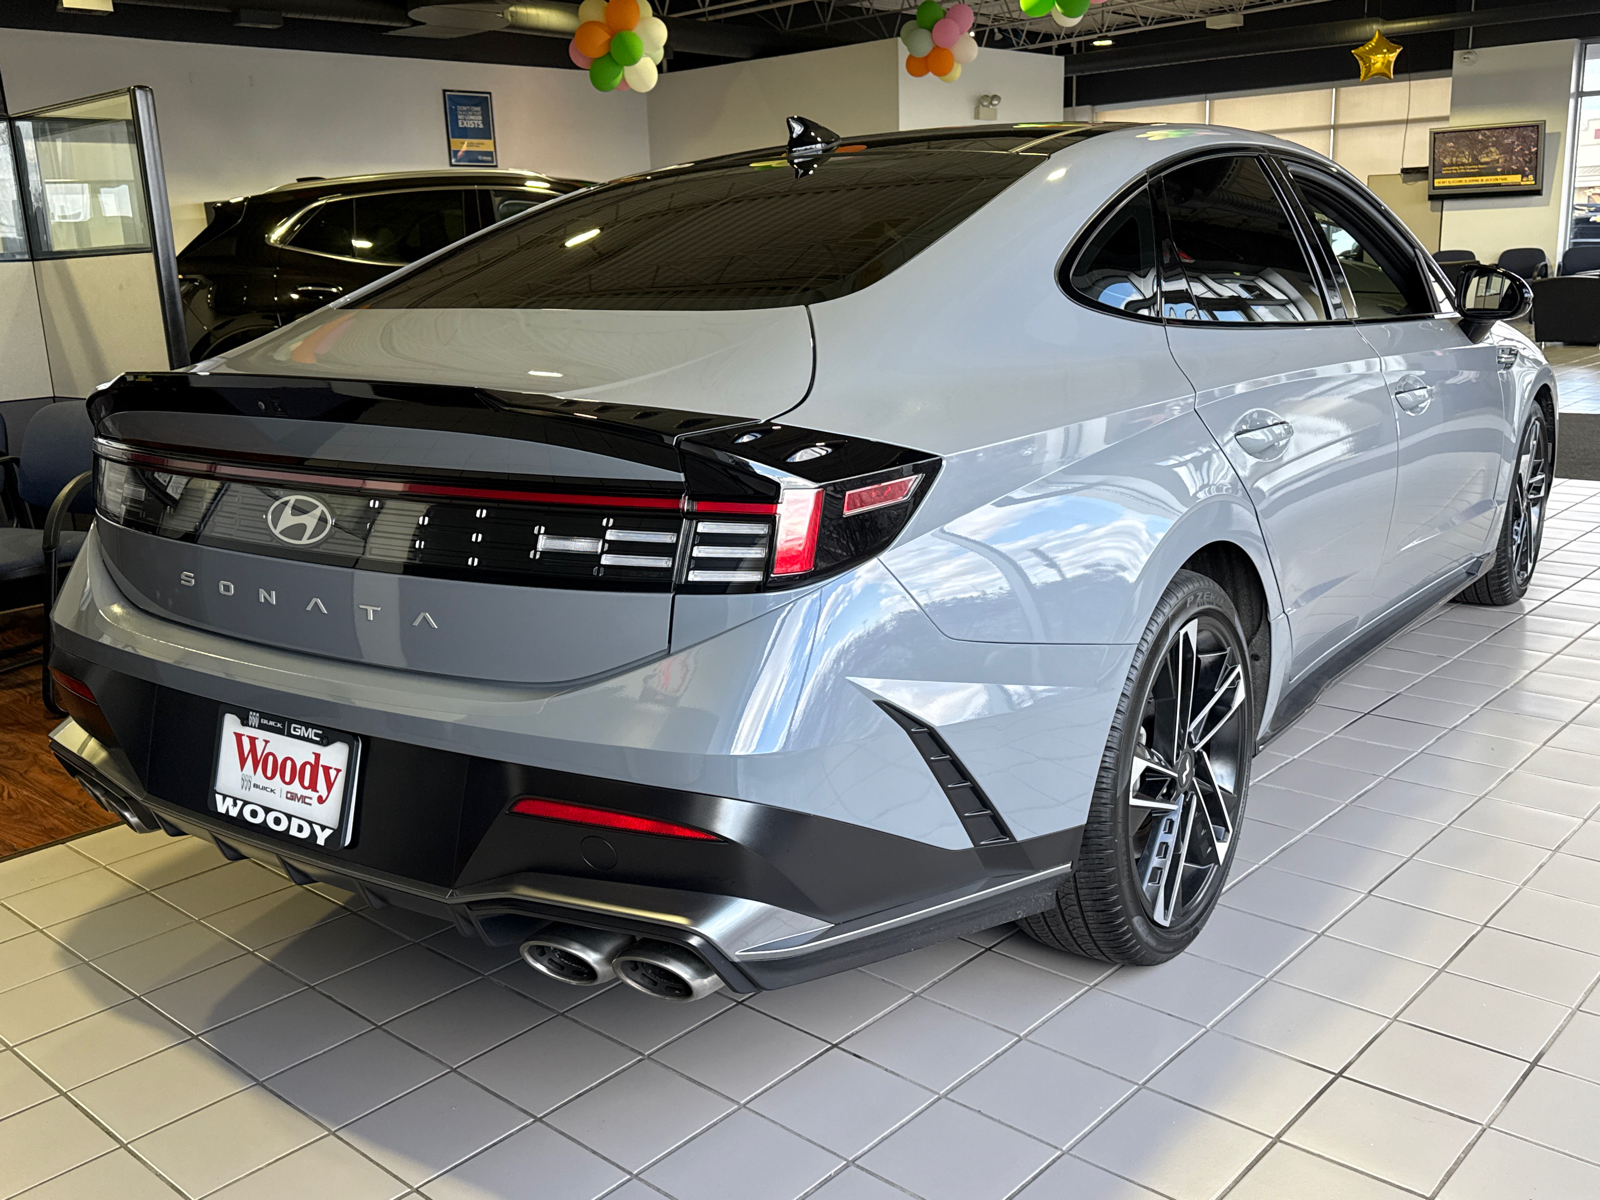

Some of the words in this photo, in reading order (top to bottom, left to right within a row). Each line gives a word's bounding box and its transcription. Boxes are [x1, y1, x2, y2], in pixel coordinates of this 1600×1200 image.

[180, 571, 438, 629] SONATA
[260, 718, 283, 728] BUICK
[290, 724, 322, 741] GMC
[233, 732, 342, 804] Woody
[253, 782, 276, 794] BUICK
[285, 791, 312, 806] GMC
[215, 794, 334, 846] WOODY
